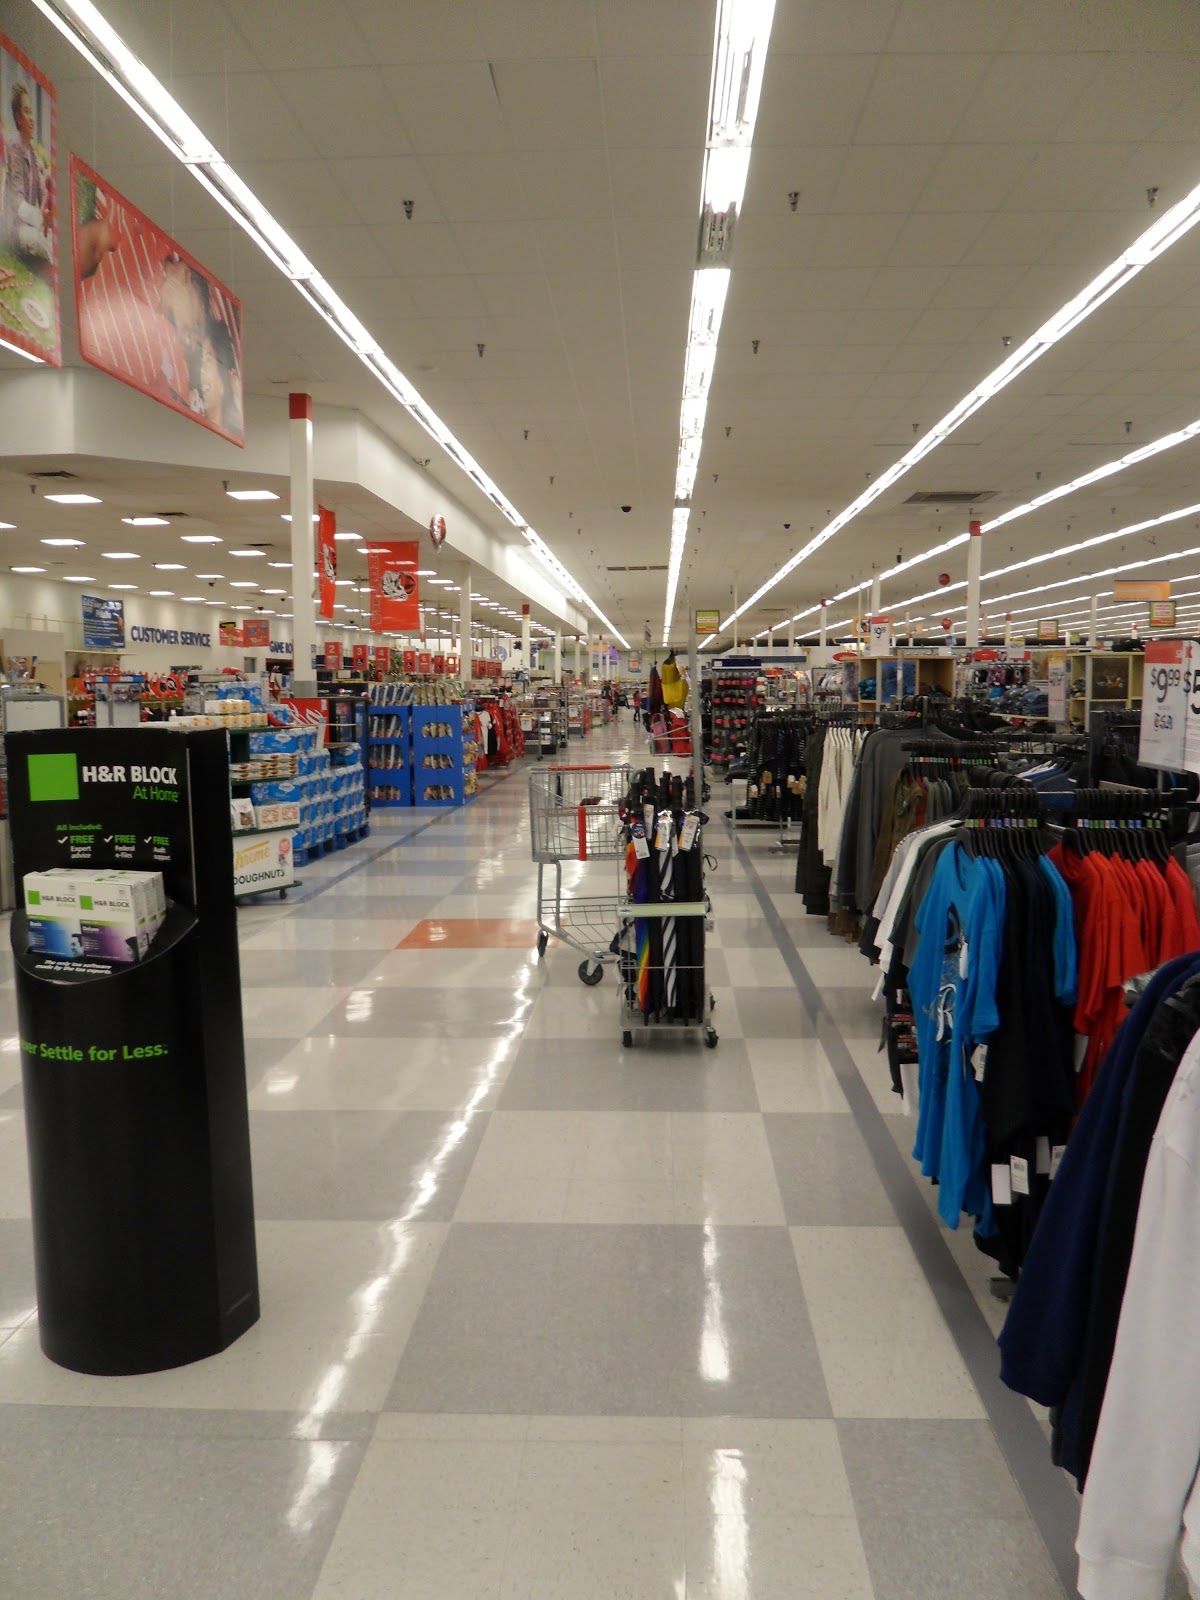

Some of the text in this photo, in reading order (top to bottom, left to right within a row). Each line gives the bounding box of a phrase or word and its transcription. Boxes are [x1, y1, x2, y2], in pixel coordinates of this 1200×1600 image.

[131, 625, 180, 645] CUSTOMER
[181, 630, 211, 648] SERVICE
[270, 640, 285, 653] GAME
[329, 645, 335, 653] 2
[357, 648, 362, 656] 3
[378, 649, 384, 657] 4
[82, 765, 178, 785] H&R BLOCK
[133, 785, 178, 802] At Home
[70, 835, 95, 844] FREE
[114, 835, 136, 844] FREE
[152, 836, 170, 846] FREE
[233, 869, 285, 886] DOUGHNUTS
[40, 1043, 83, 1061] Settle
[88, 1046, 117, 1061] for
